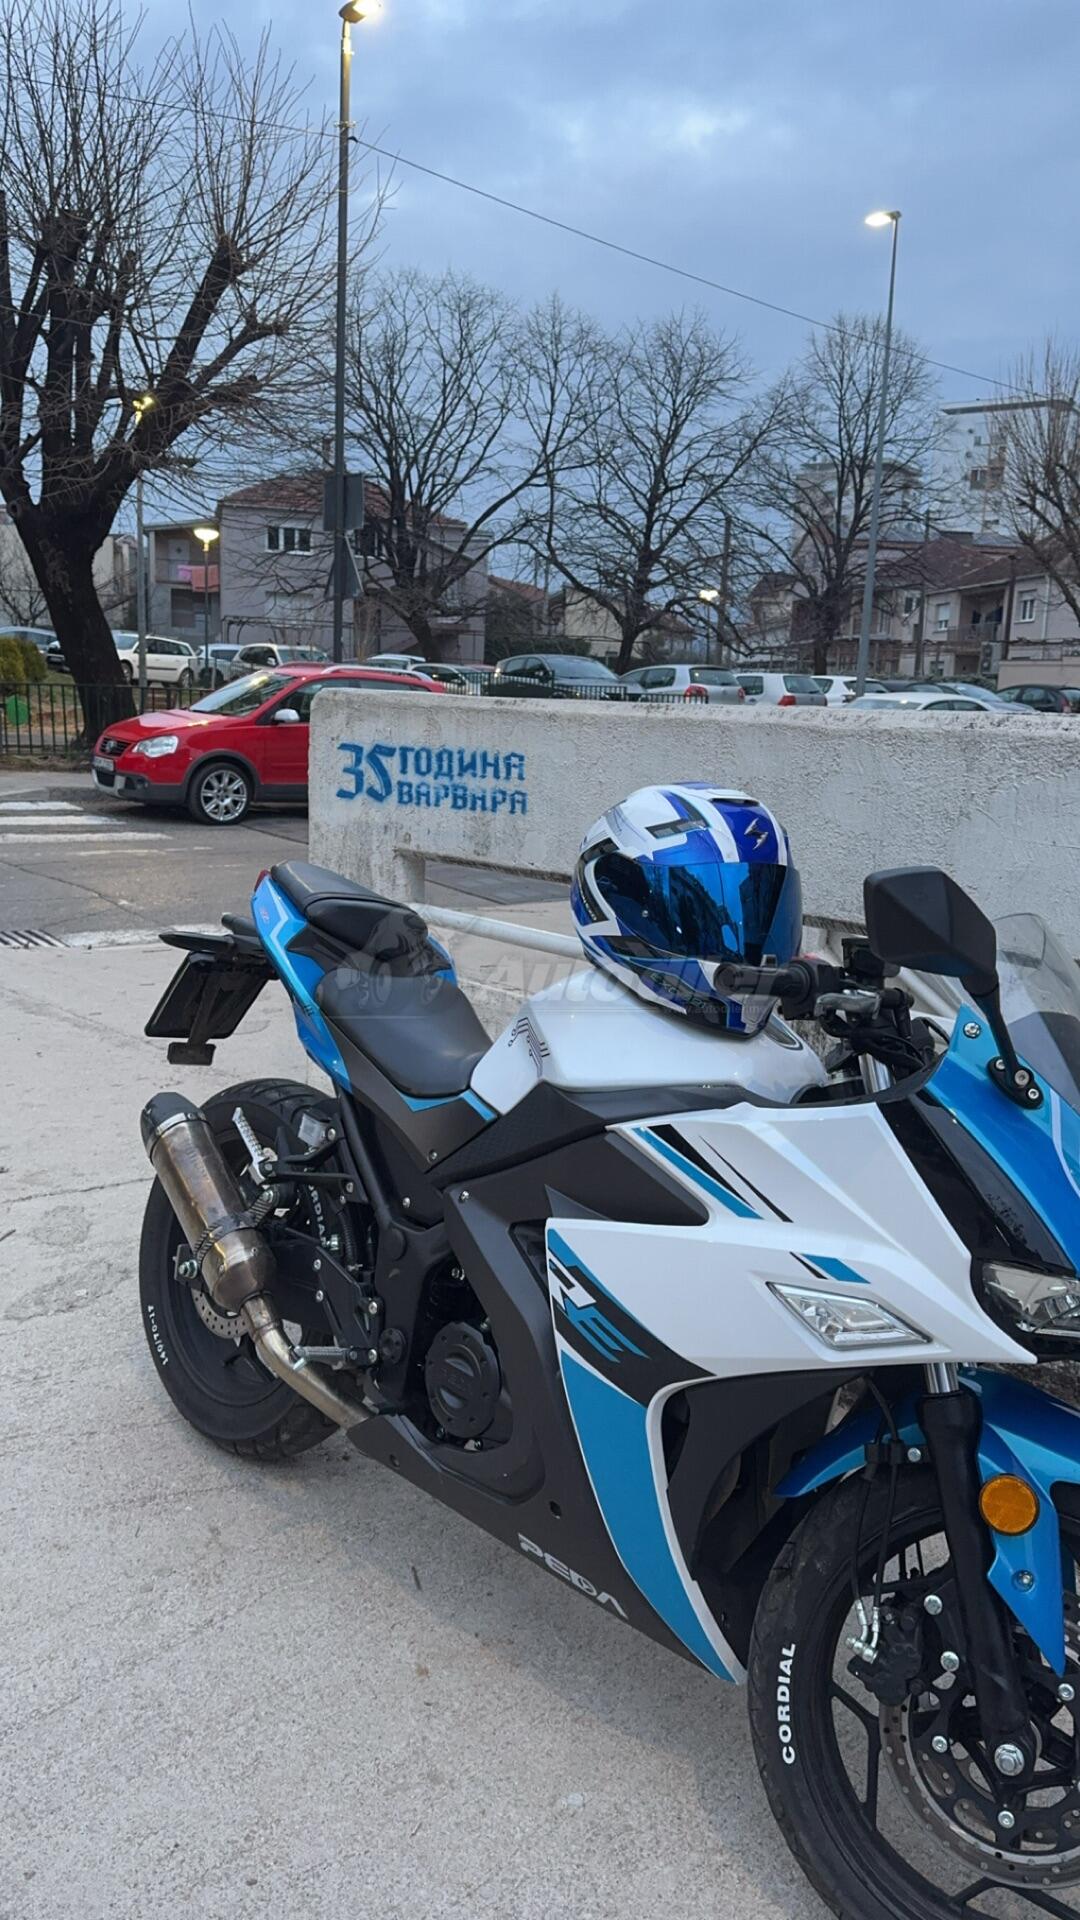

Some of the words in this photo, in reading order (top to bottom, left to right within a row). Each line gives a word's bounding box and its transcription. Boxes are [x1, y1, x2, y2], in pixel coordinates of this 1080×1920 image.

[336, 743, 397, 802] 35
[399, 746, 526, 781] ГОДИНА
[776, 1642, 797, 1765] CORDIAL
